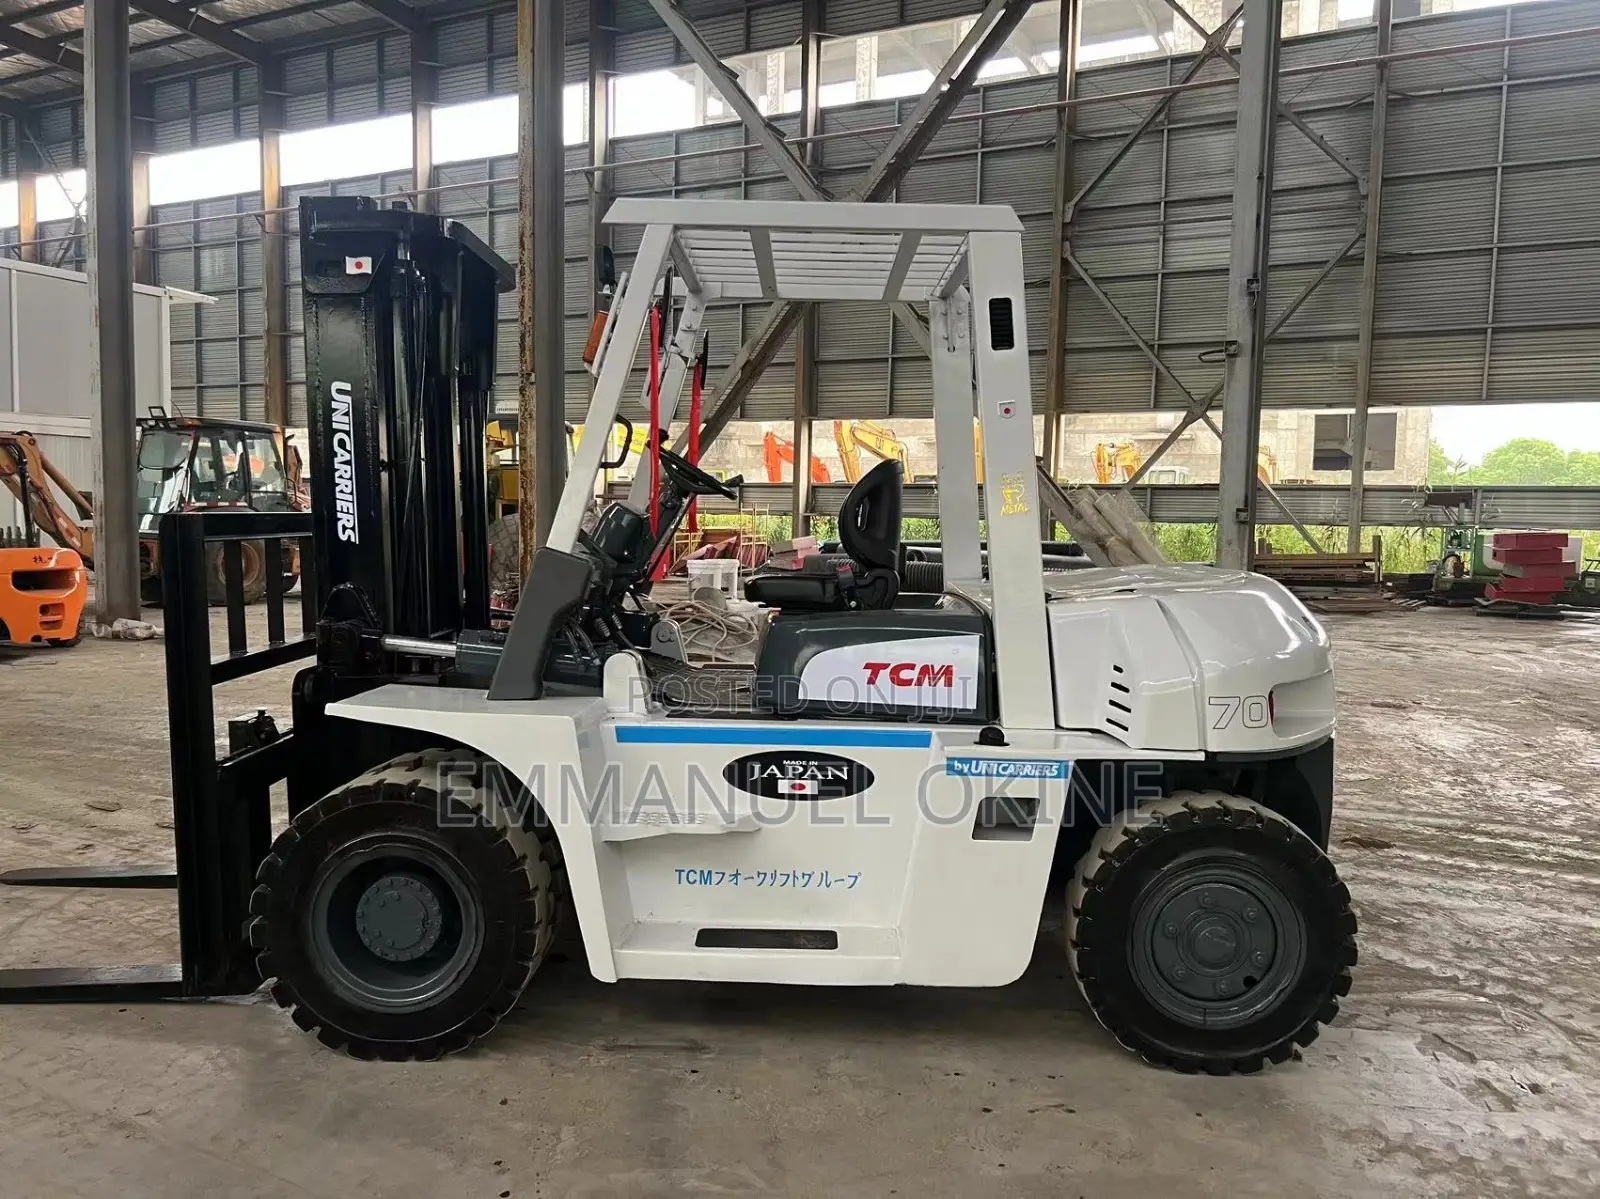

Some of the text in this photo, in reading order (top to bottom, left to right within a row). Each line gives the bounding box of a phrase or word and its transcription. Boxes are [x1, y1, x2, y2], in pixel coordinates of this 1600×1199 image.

[331, 380, 358, 544] UNICARRIERS
[863, 662, 953, 688] TCM
[1208, 695, 1269, 730] 70
[748, 764, 849, 781] JAPAN
